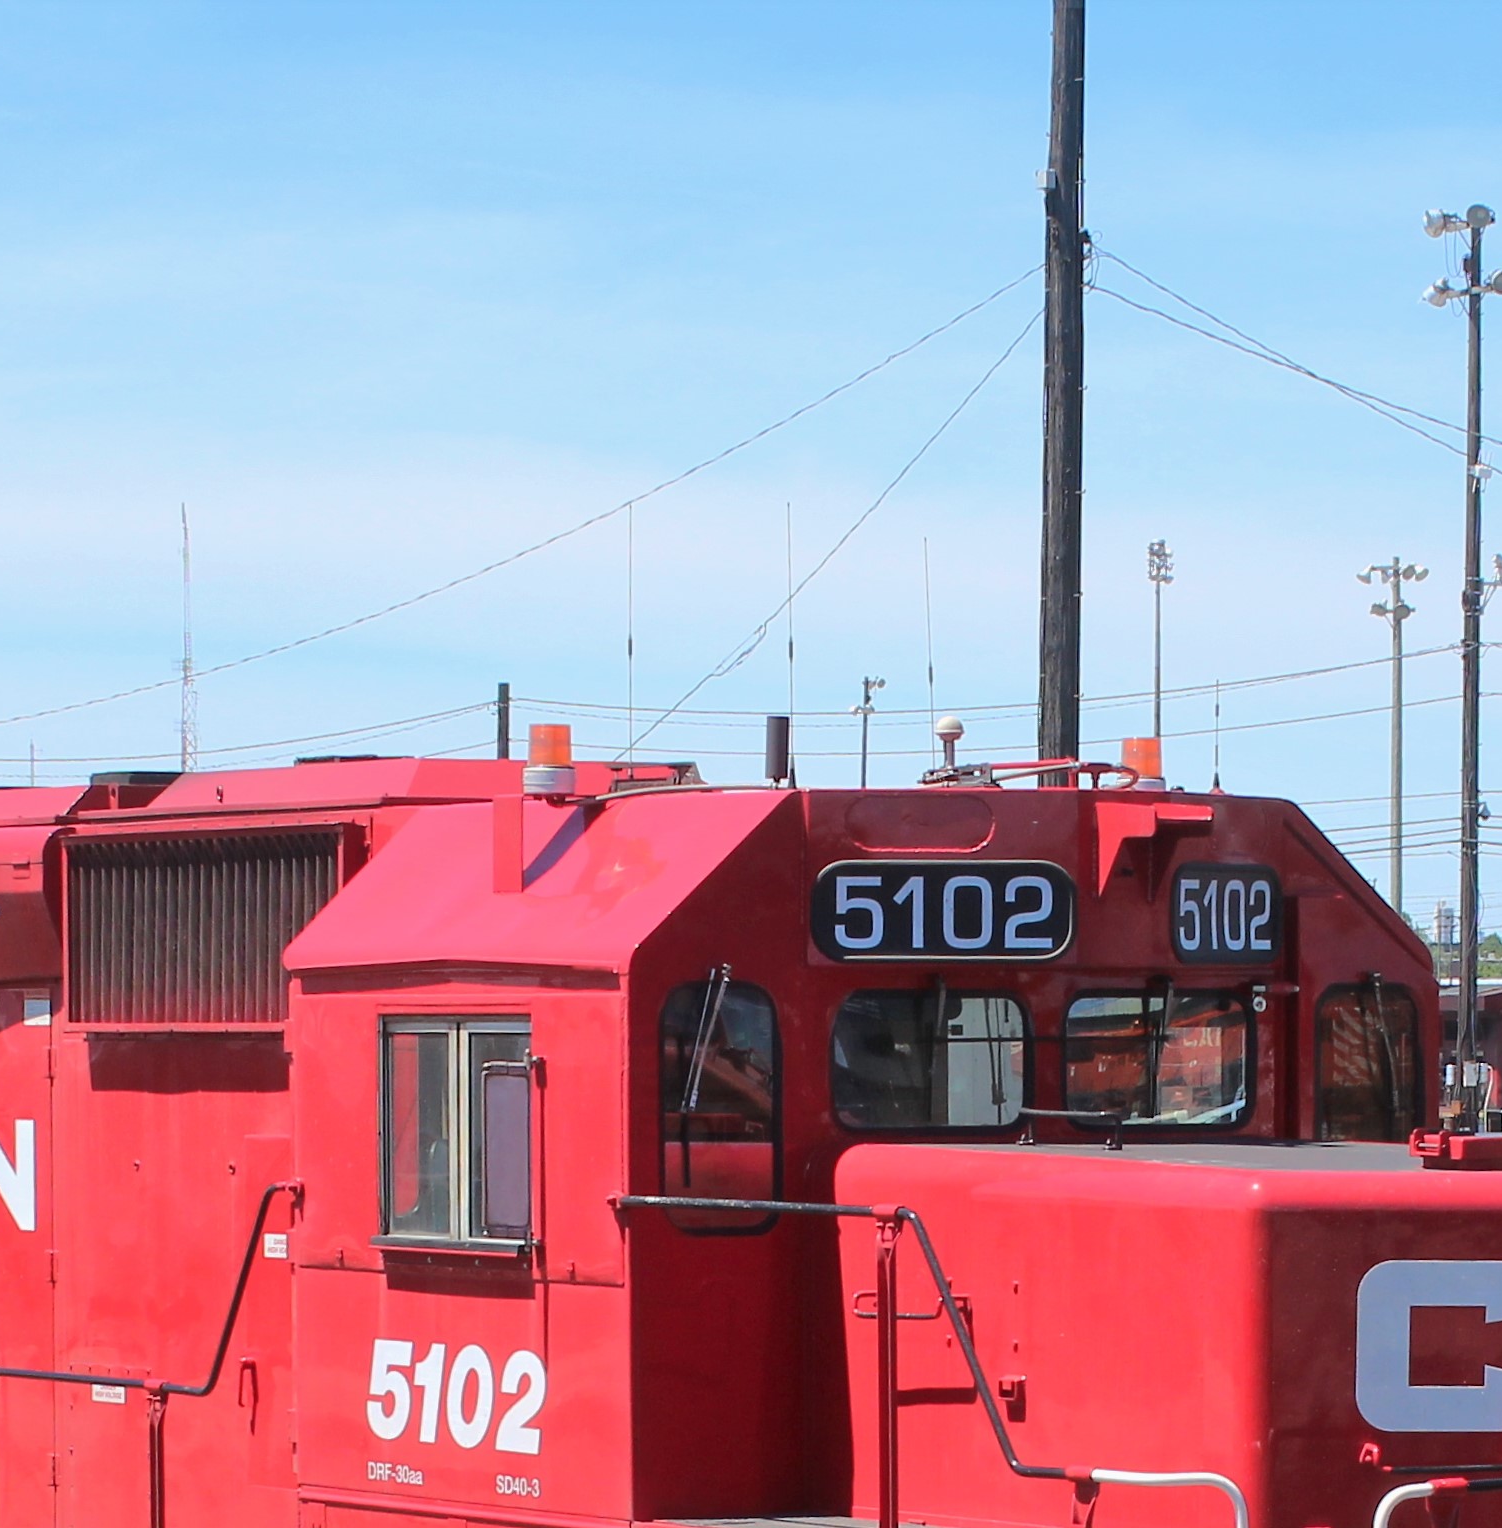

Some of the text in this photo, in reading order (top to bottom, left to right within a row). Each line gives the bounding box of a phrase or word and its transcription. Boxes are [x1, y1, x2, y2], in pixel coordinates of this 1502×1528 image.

[834, 875, 1054, 949] 5102
[1178, 878, 1273, 951] 5102
[366, 1337, 547, 1455] 5102
[367, 1461, 541, 1498] DRF-30aa SD40-3
